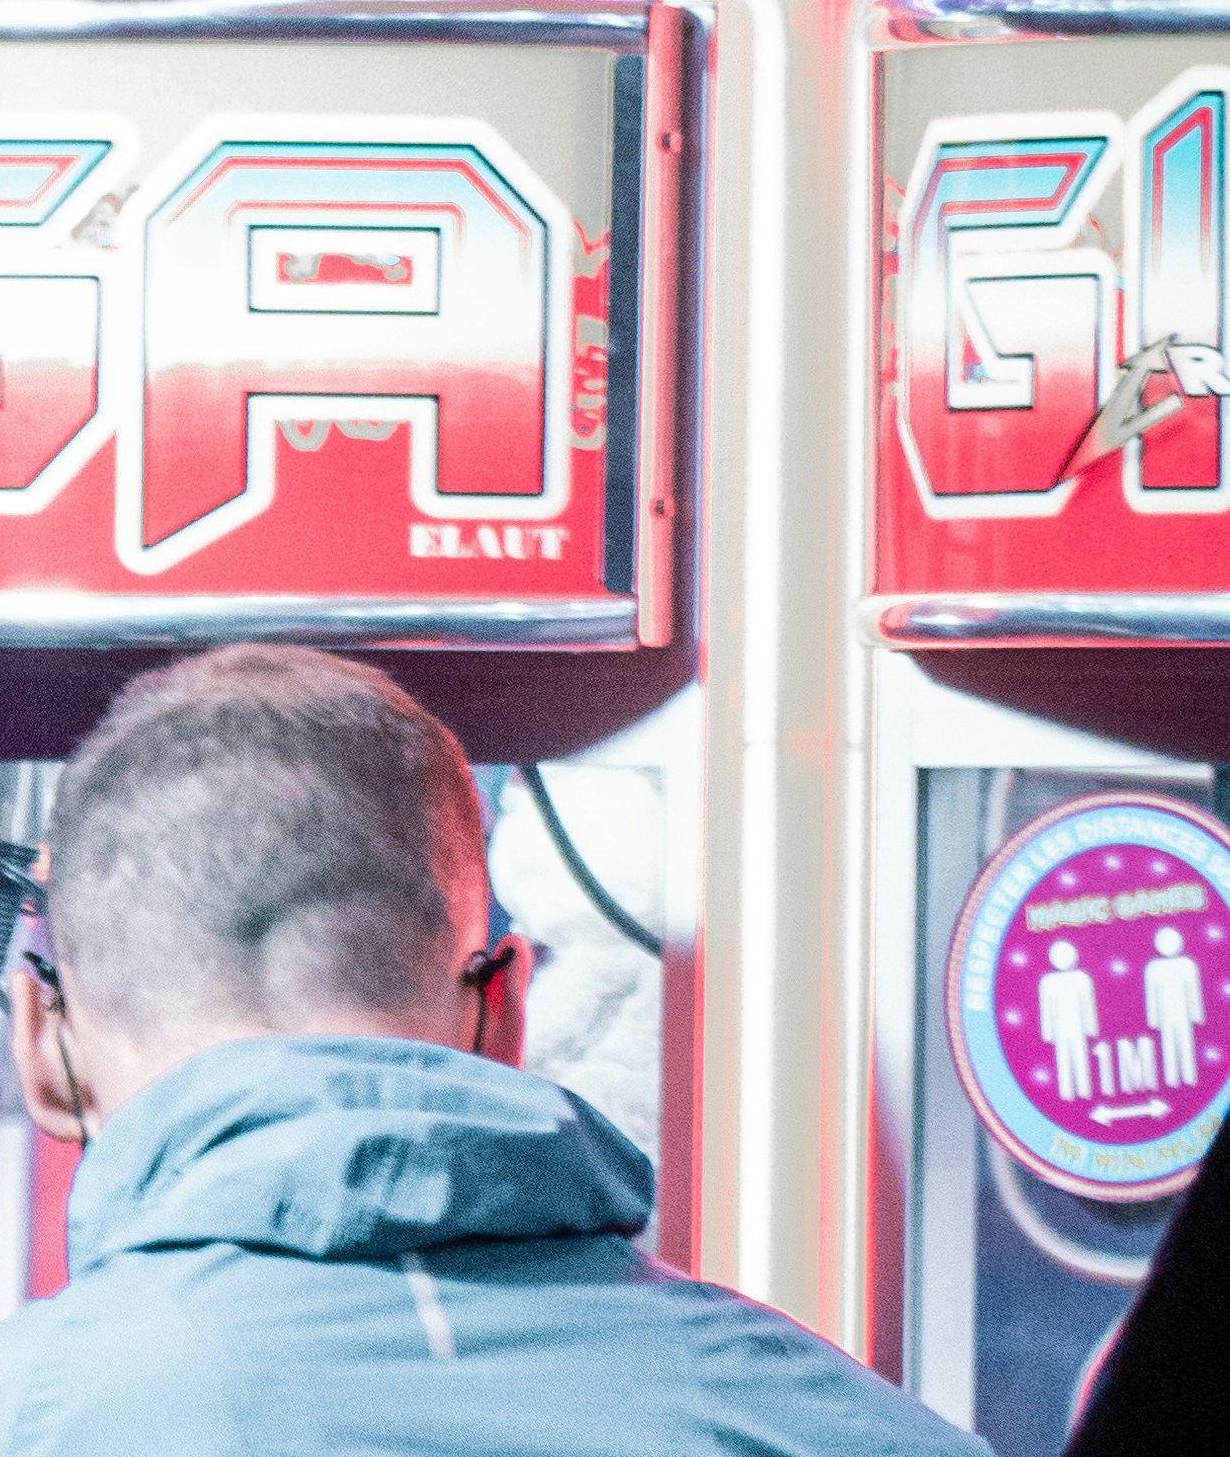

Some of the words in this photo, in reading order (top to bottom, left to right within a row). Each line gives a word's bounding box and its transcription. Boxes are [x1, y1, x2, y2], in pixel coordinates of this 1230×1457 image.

[408, 522, 570, 560] ELAUT
[965, 862, 1036, 1012] RESPECTER
[1027, 829, 1076, 868] LES
[1075, 815, 1208, 862] DISTANCES
[1026, 895, 1111, 933] MAGIC
[1112, 882, 1208, 920] GAMES
[1093, 1035, 1159, 1097] 1M
